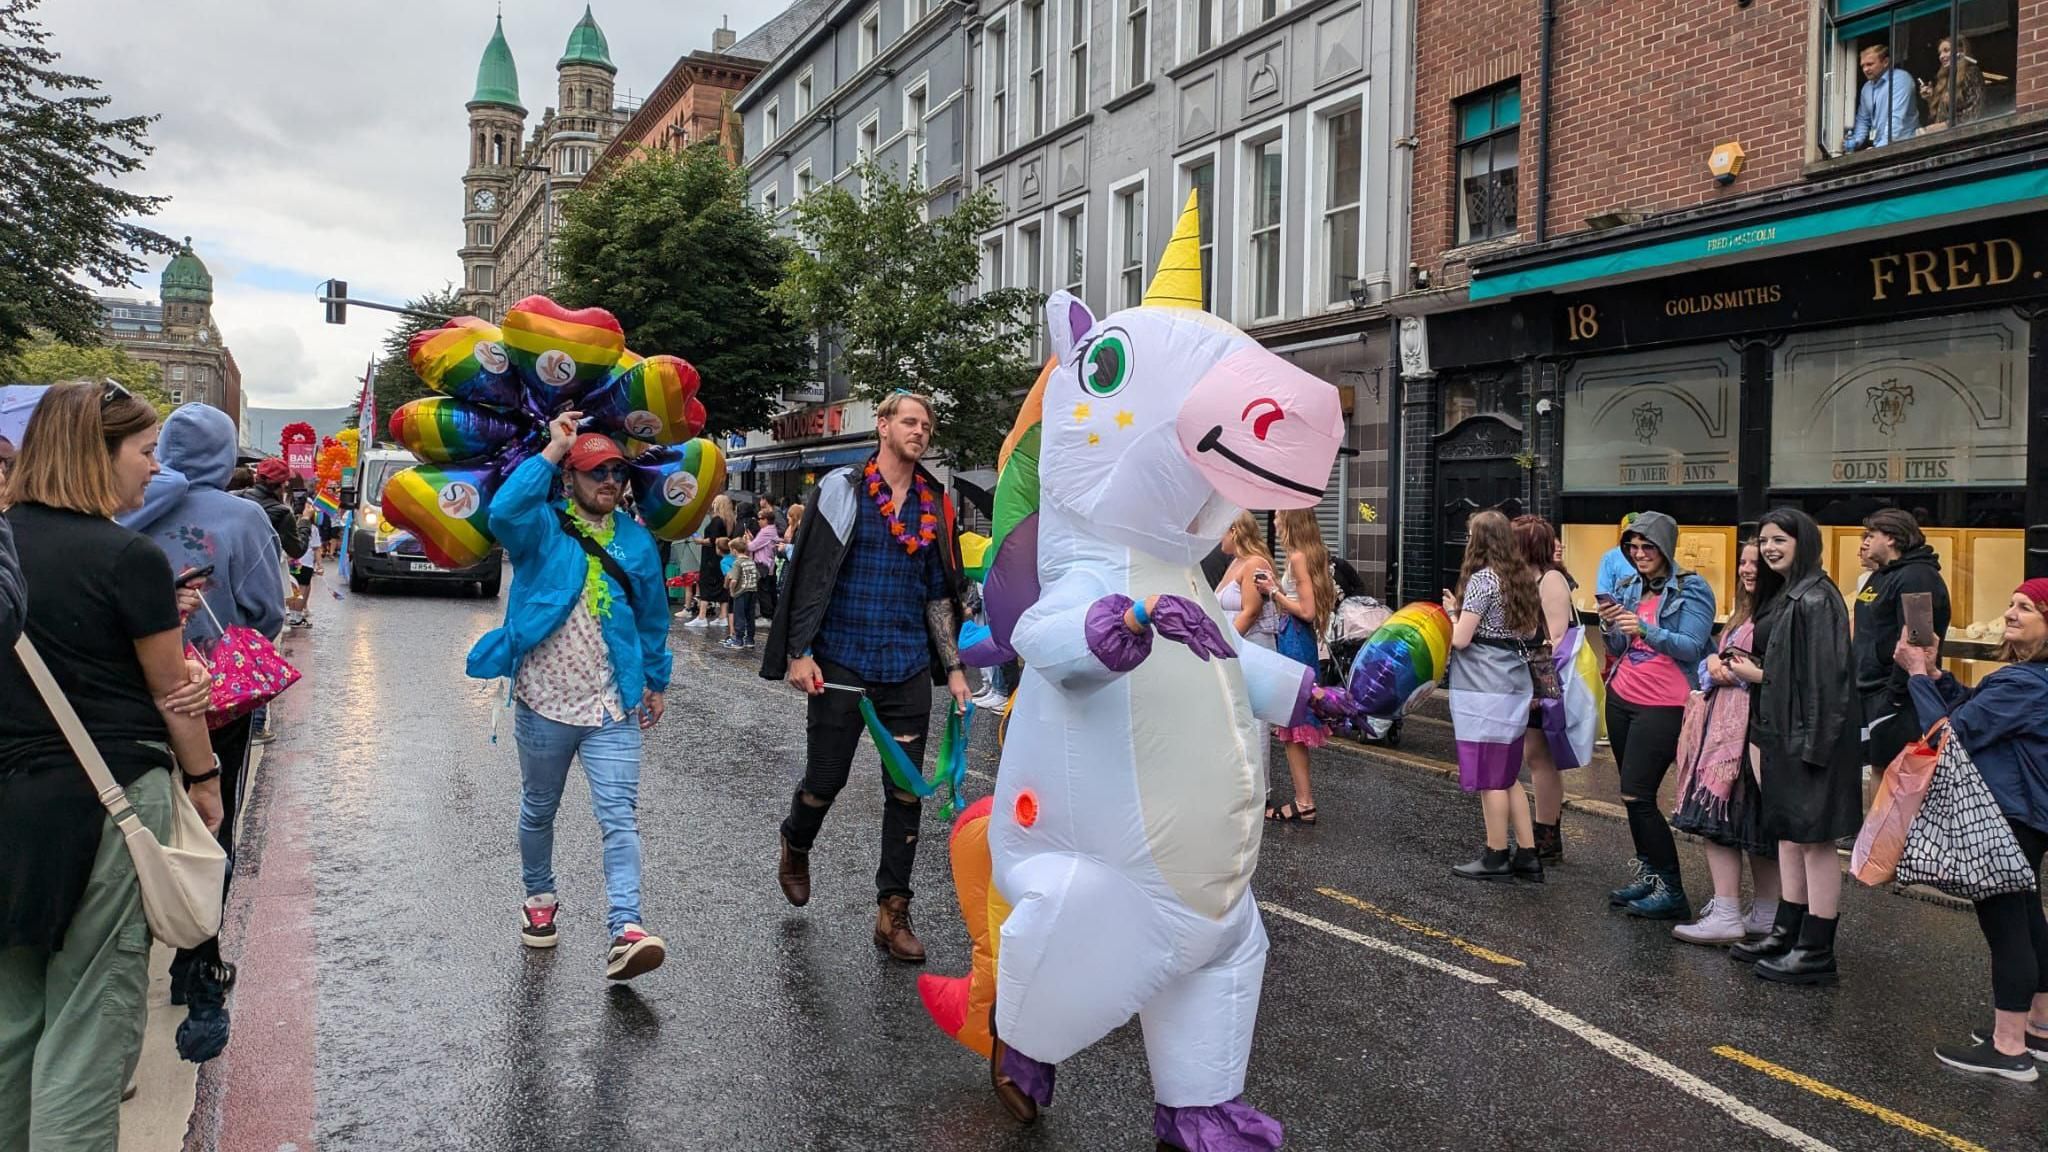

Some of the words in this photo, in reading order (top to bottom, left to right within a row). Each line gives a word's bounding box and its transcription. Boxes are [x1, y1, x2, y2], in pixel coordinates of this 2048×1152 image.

[1707, 237, 1728, 251] FRED
[1665, 285, 1782, 317] GOLDSMITHS
[1568, 303, 1599, 341] 18
[289, 454, 312, 463] BAN
[1832, 460, 1949, 480] GOLDSITHS
